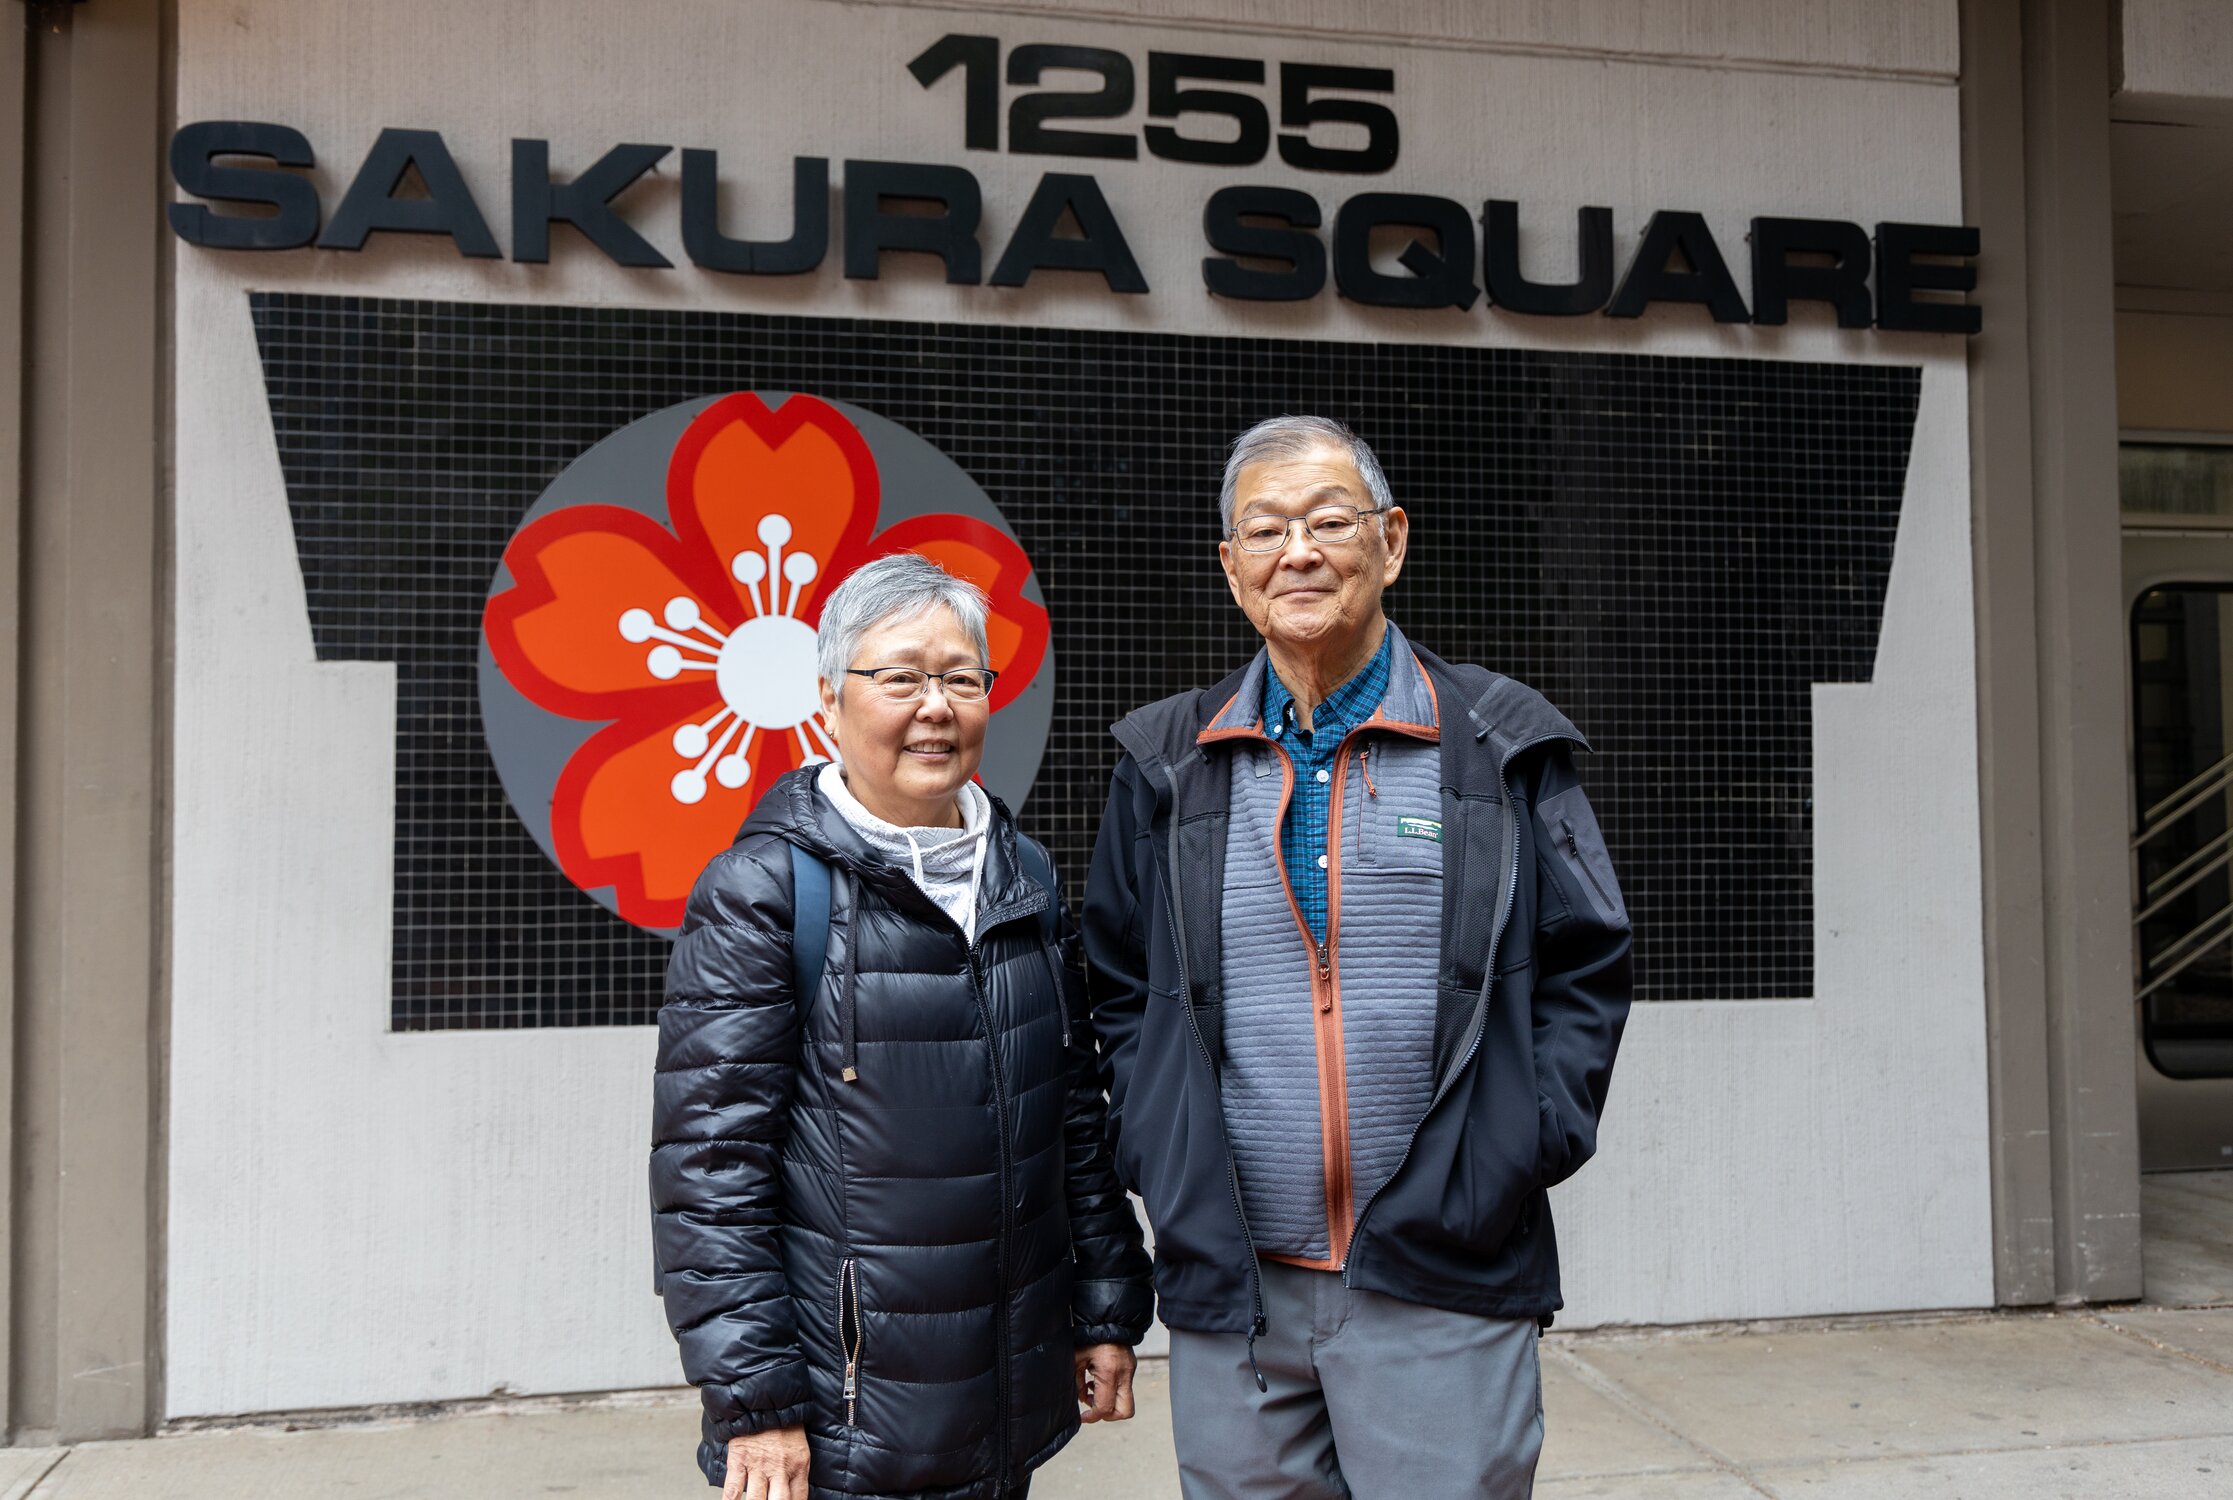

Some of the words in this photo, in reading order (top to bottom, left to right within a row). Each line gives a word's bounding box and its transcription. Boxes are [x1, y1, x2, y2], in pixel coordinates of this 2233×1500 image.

[906, 33, 1400, 174] 1255
[168, 121, 1149, 294] SAKURA
[1202, 185, 1982, 334] SQUARE
